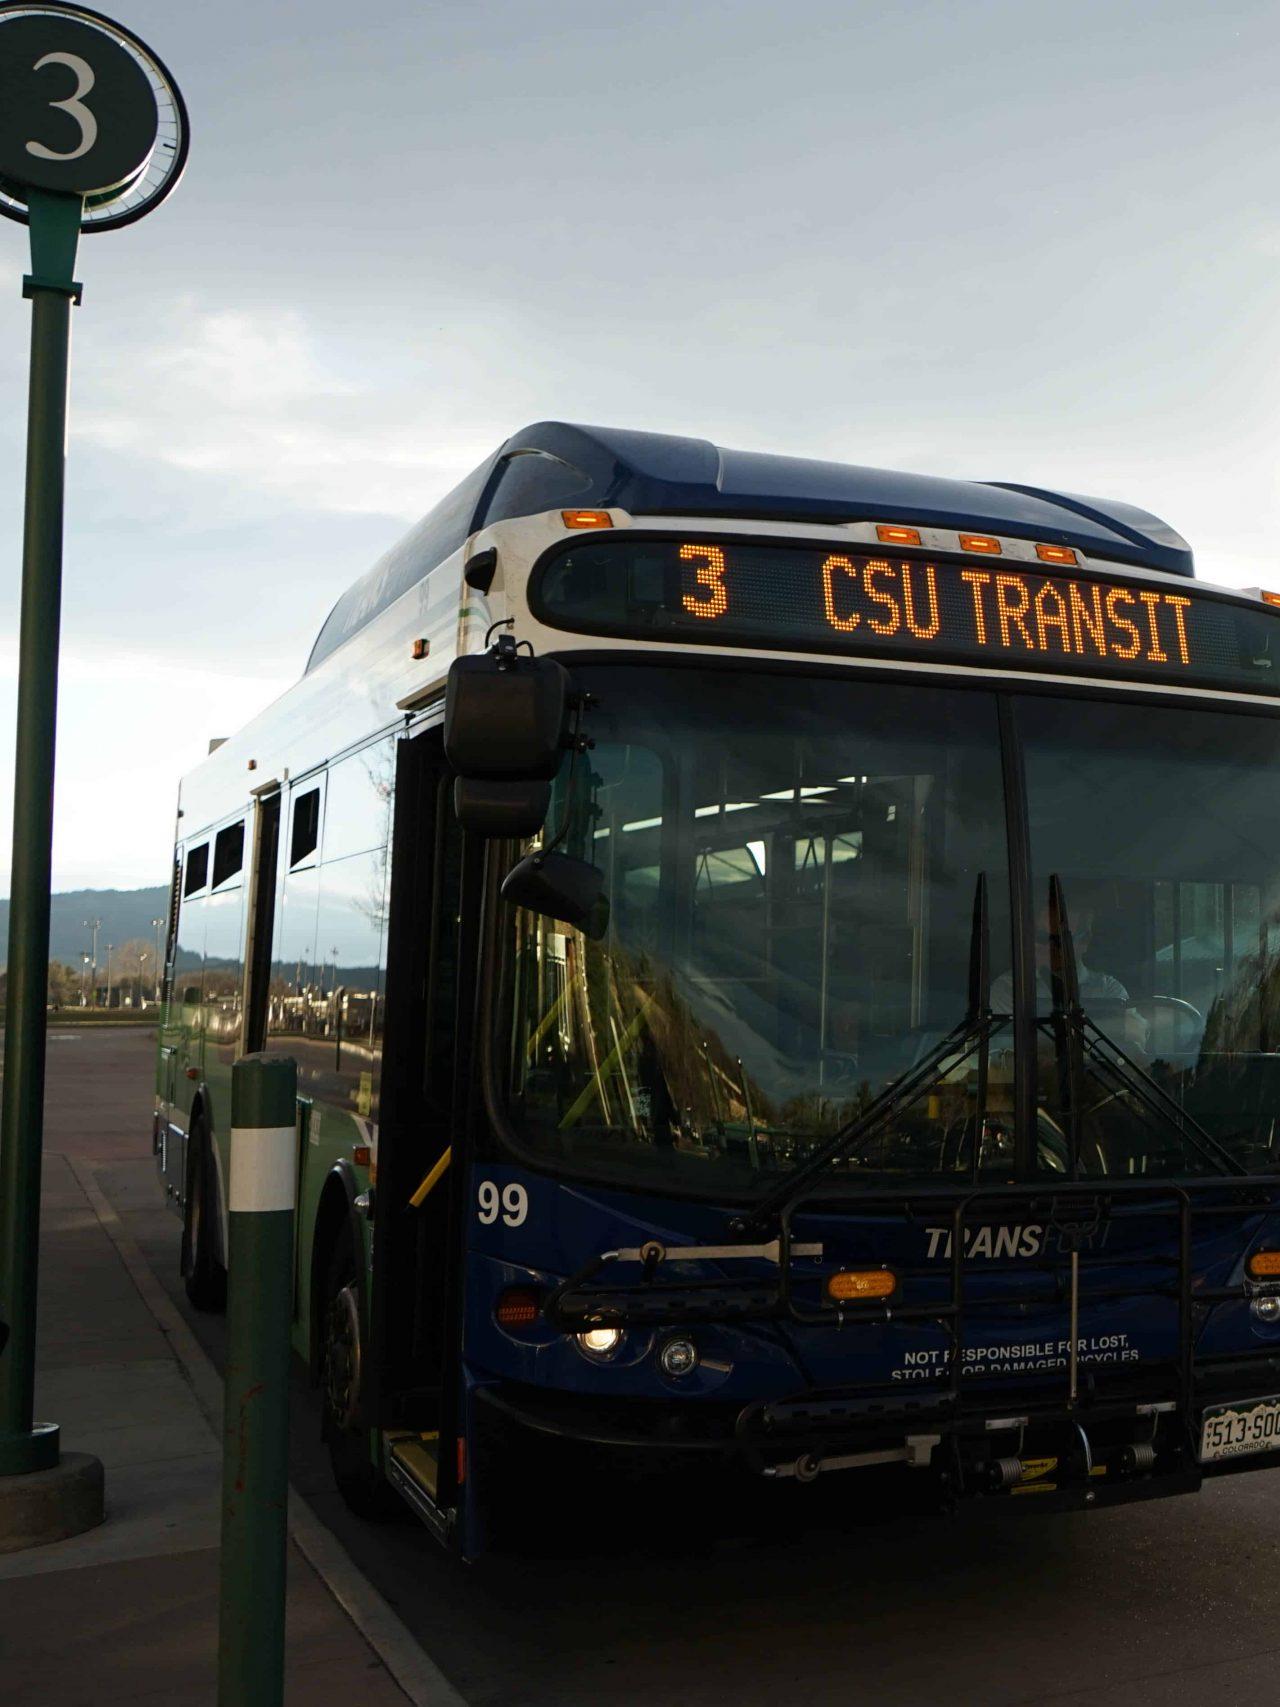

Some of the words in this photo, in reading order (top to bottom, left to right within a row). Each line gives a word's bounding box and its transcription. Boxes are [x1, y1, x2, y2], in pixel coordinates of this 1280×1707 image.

[25, 51, 98, 161] 3
[679, 544, 727, 618] 3
[822, 555, 940, 639] CSU
[961, 570, 1191, 664] TRANSIT
[478, 1181, 528, 1227] 99
[904, 1351, 938, 1365] NOT
[1091, 1334, 1128, 1349] LOST,
[1222, 1440, 1265, 1455] COLORADO
